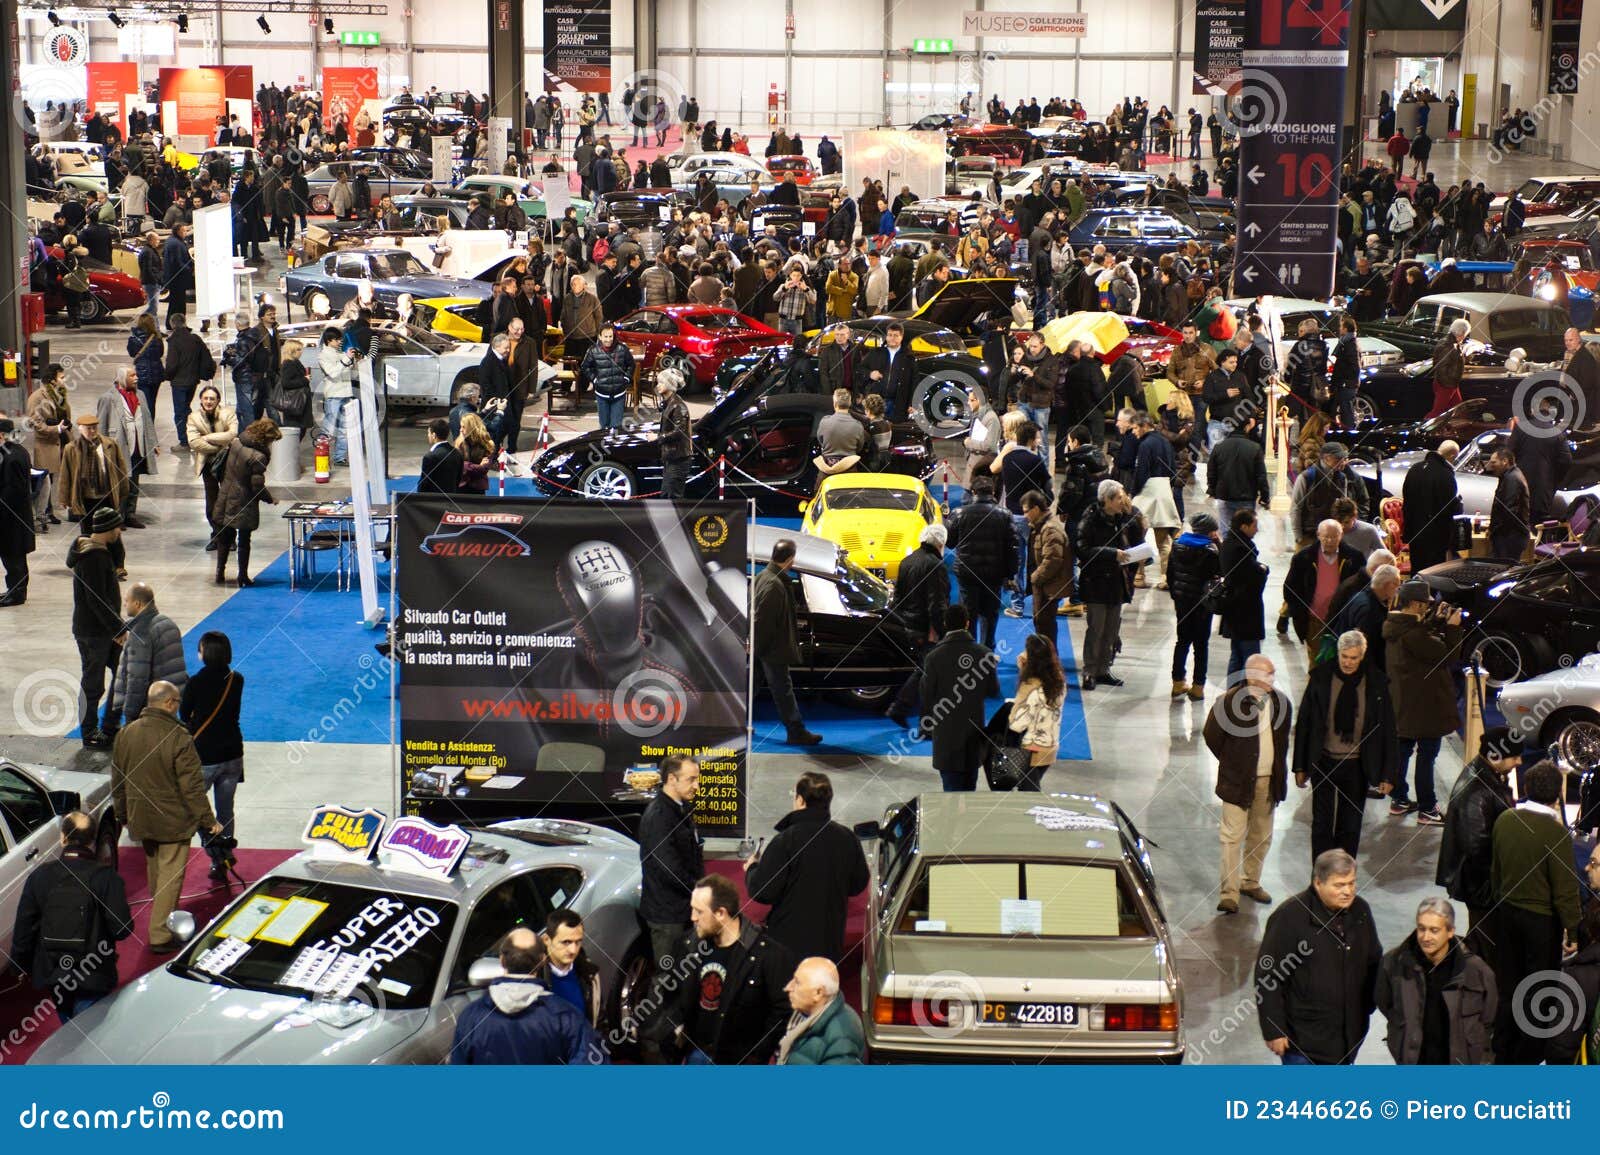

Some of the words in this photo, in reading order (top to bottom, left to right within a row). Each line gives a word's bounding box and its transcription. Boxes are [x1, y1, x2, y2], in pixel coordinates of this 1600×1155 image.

[965, 16, 1027, 32] MUSEO
[1248, 124, 1261, 133] AL
[1265, 124, 1336, 133] PADIGLIONE
[1273, 134, 1287, 144] TO
[1290, 134, 1308, 144] THE
[1311, 134, 1336, 144] HALL
[1277, 153, 1333, 197] 10
[446, 514, 471, 523] CAR
[474, 513, 520, 523] OUTLET
[430, 543, 523, 557] SILVAUTO
[585, 576, 625, 591] SILVAUTO
[404, 609, 449, 624] Silvauto
[452, 610, 471, 624] Car
[474, 611, 506, 626] Outlet
[404, 630, 446, 646] qualità,
[450, 631, 492, 645] servizio
[495, 634, 501, 646] e
[505, 633, 576, 648] convenienza:
[405, 651, 415, 664] la
[418, 652, 452, 665] nostra
[456, 652, 494, 666] marcia
[497, 652, 507, 666] in
[510, 652, 531, 669] più!
[462, 693, 681, 721] www.silvauto.it
[406, 740, 438, 750] Vendita
[448, 741, 496, 752] Assistenza:
[641, 745, 665, 756] Show
[667, 746, 692, 755] Room
[702, 746, 737, 757] Vendita:
[405, 754, 444, 764] Grumello
[446, 755, 458, 764] del
[460, 755, 486, 765] Monte
[488, 755, 507, 767] (Bg)
[700, 760, 737, 772] Bergamo
[698, 774, 737, 786] lpensata)
[695, 787, 737, 798] 42.43.575
[695, 801, 737, 811] 38.40.040
[322, 813, 365, 834] FULL
[694, 814, 737, 825] silvauto.it
[311, 825, 370, 848] OPTIONAL
[357, 906, 440, 972] REZZO
[983, 1003, 1006, 1021] PG
[1017, 1004, 1074, 1023] 422818
